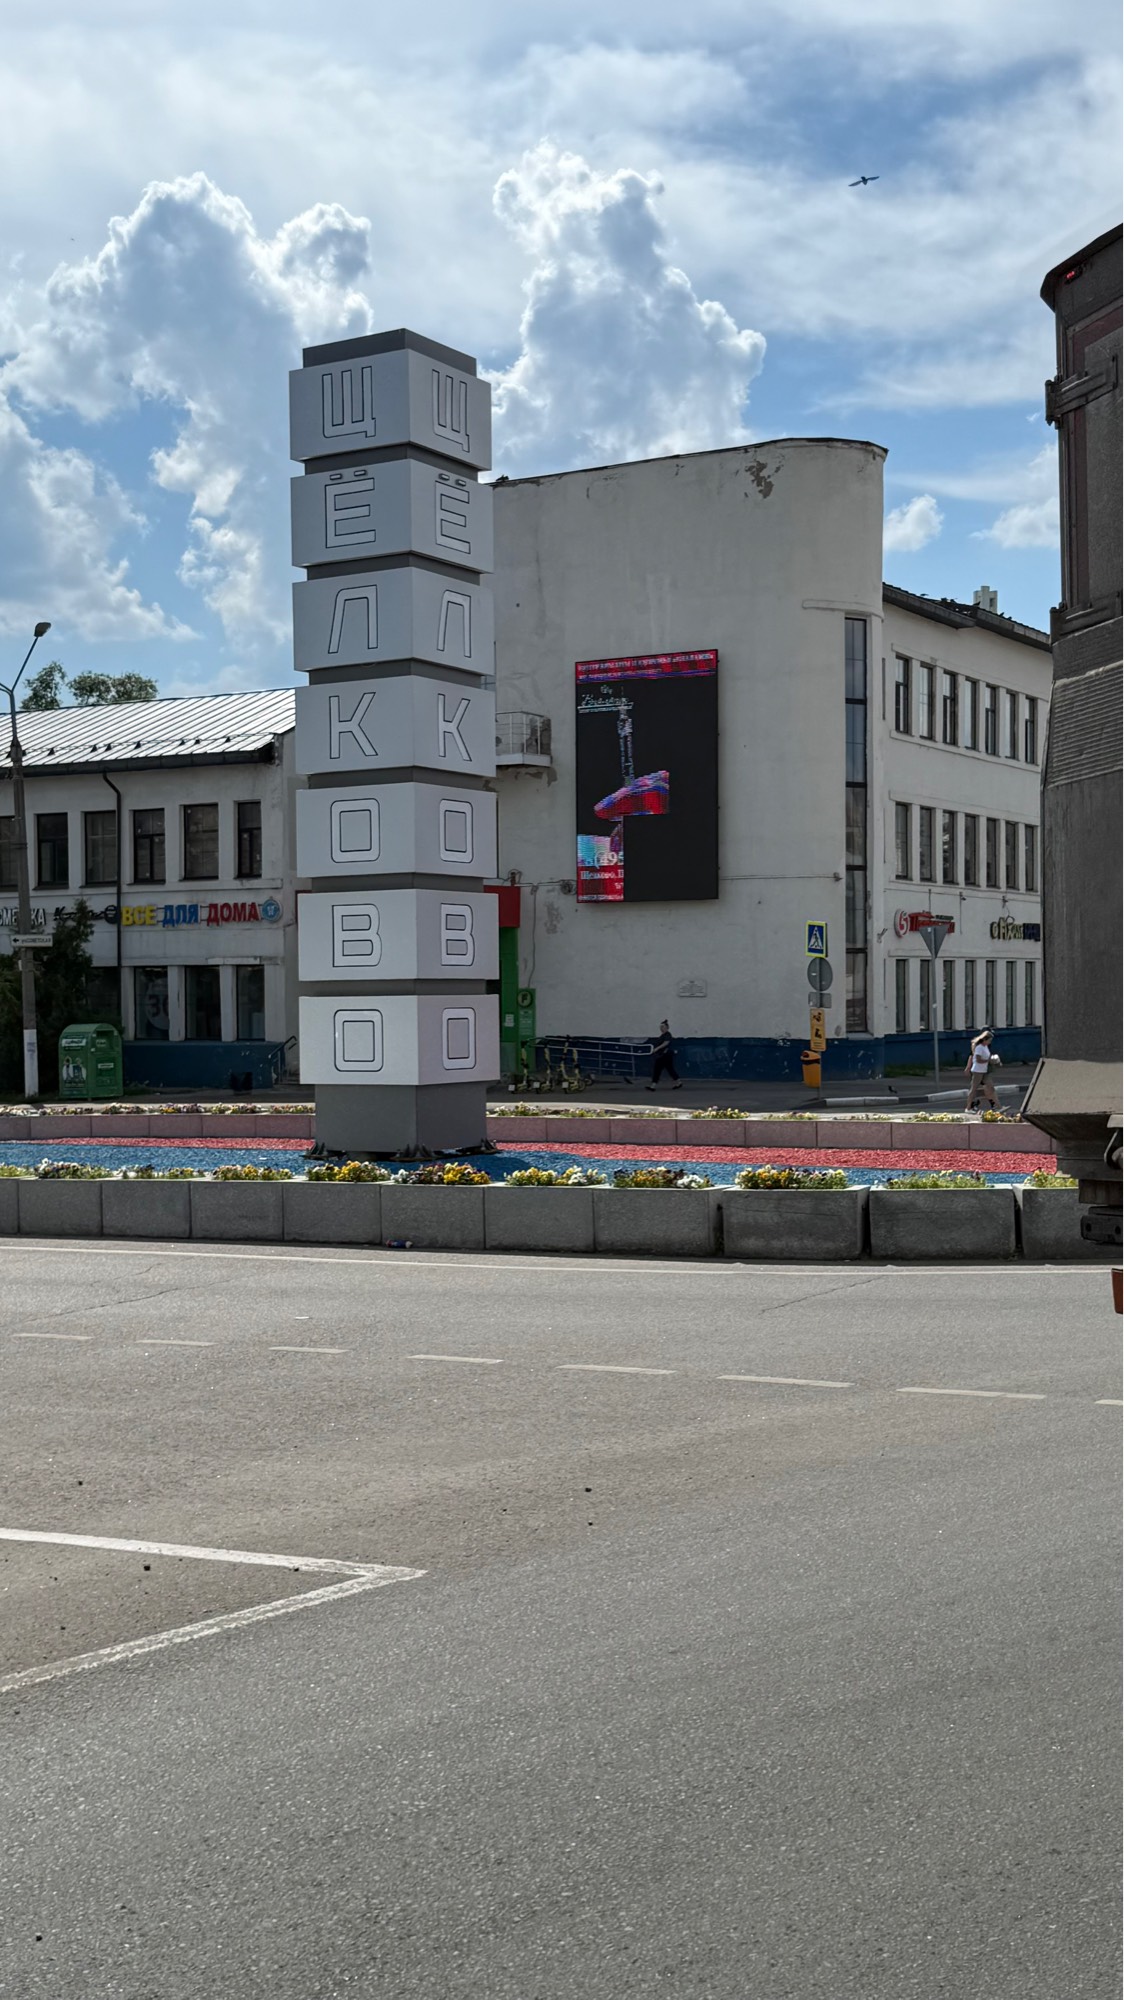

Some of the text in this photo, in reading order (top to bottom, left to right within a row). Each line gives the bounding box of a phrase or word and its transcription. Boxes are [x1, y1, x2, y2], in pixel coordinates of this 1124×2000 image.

[121, 905, 157, 926] ВСЕ
[162, 904, 199, 927] ДЛЯ
[206, 902, 260, 926] ДОМА
[321, 365, 384, 1072] ЩЁЛКОВО
[431, 368, 477, 1071] ЩЁЛКОВО
